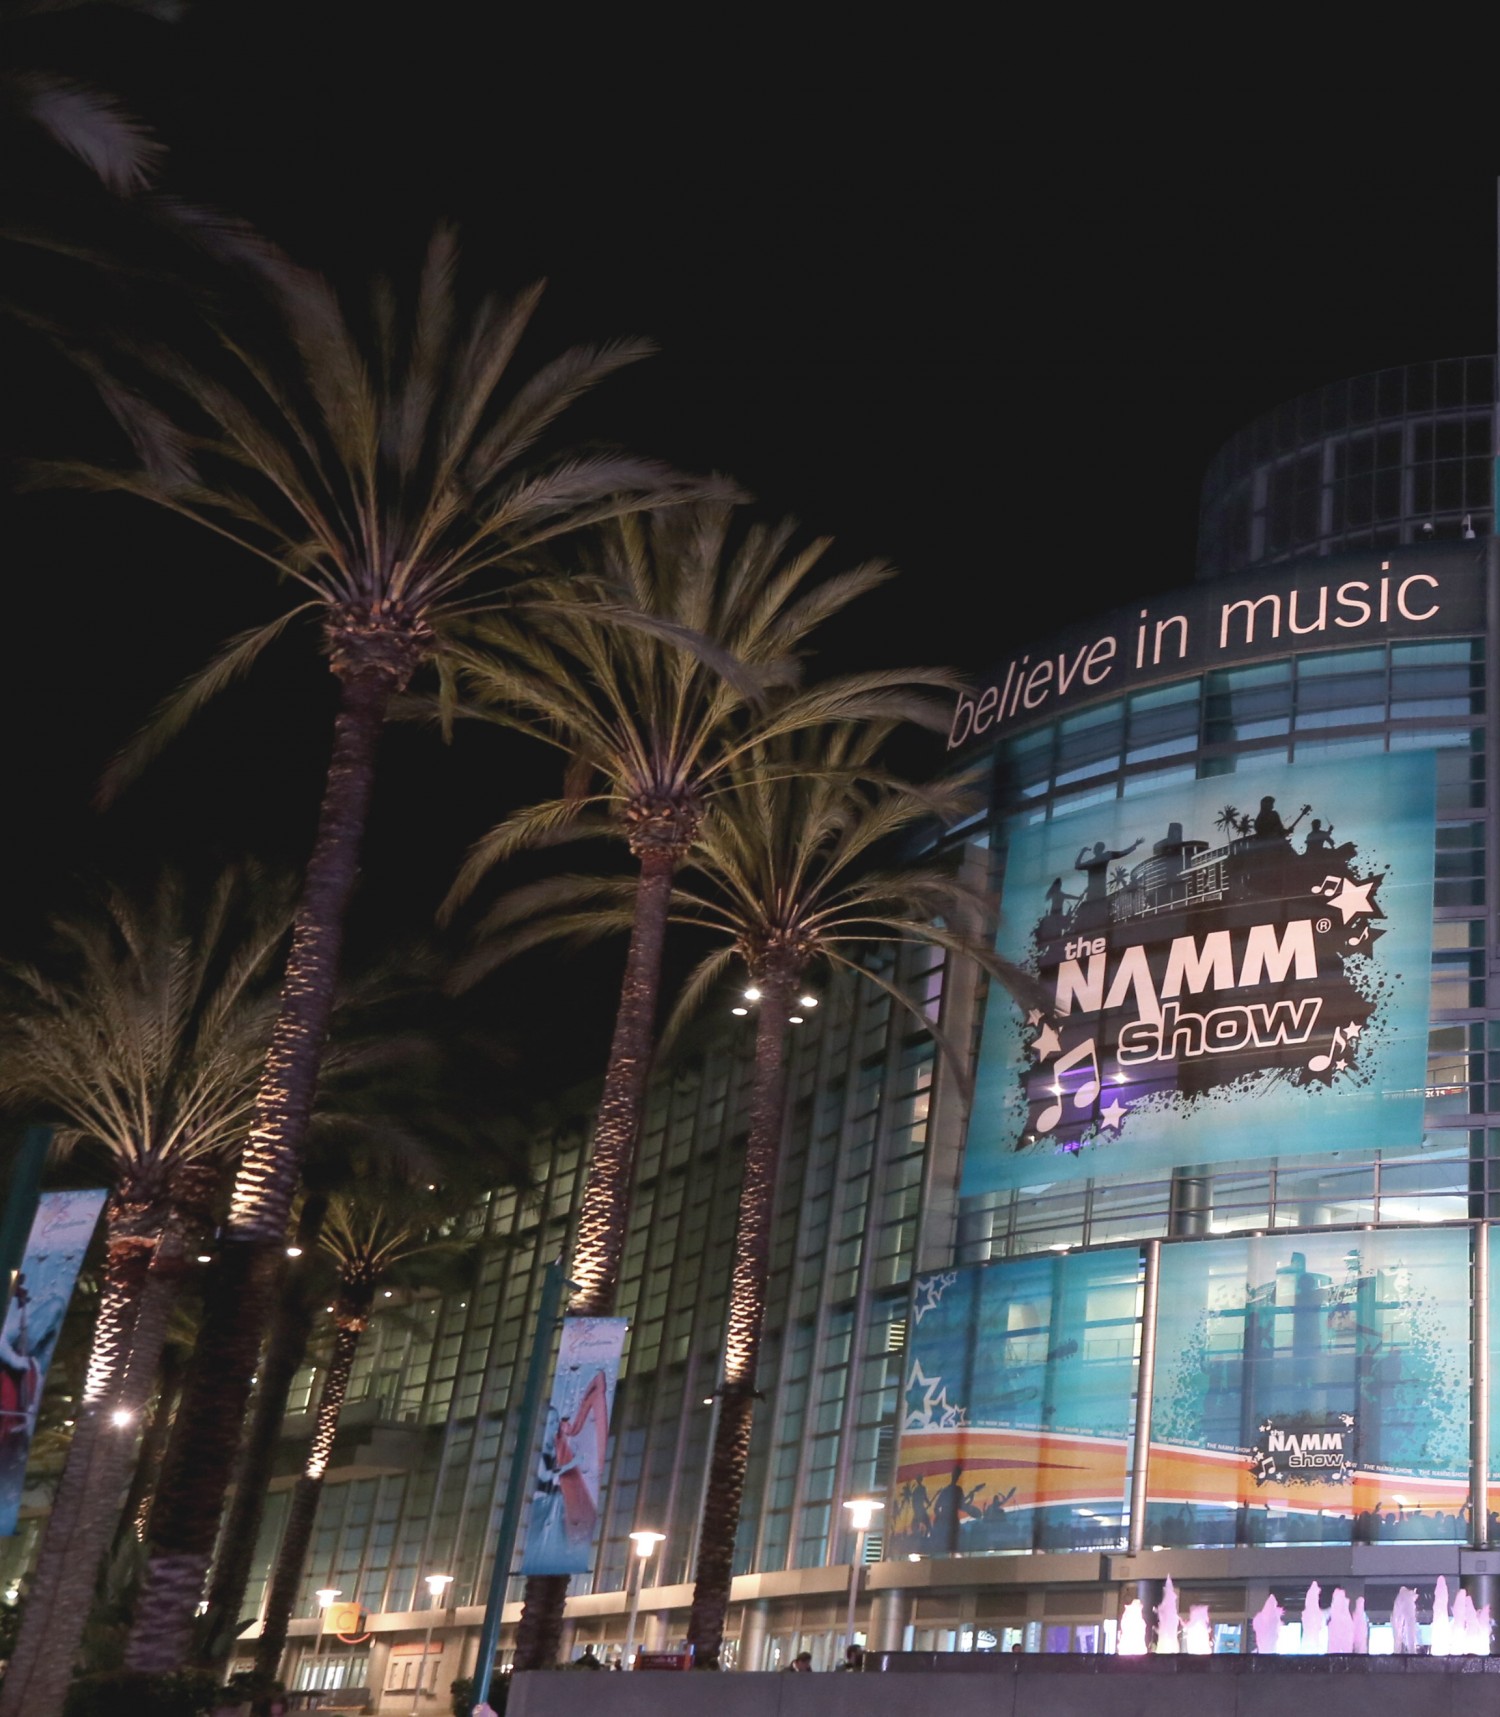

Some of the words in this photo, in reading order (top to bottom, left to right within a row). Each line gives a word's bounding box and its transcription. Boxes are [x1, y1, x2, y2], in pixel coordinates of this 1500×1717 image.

[947, 635, 1117, 752] believe
[1135, 608, 1189, 669] in
[1219, 560, 1440, 648] music
[1064, 936, 1107, 961] the
[1117, 997, 1324, 1067] show
[1288, 1452, 1344, 1467] show
